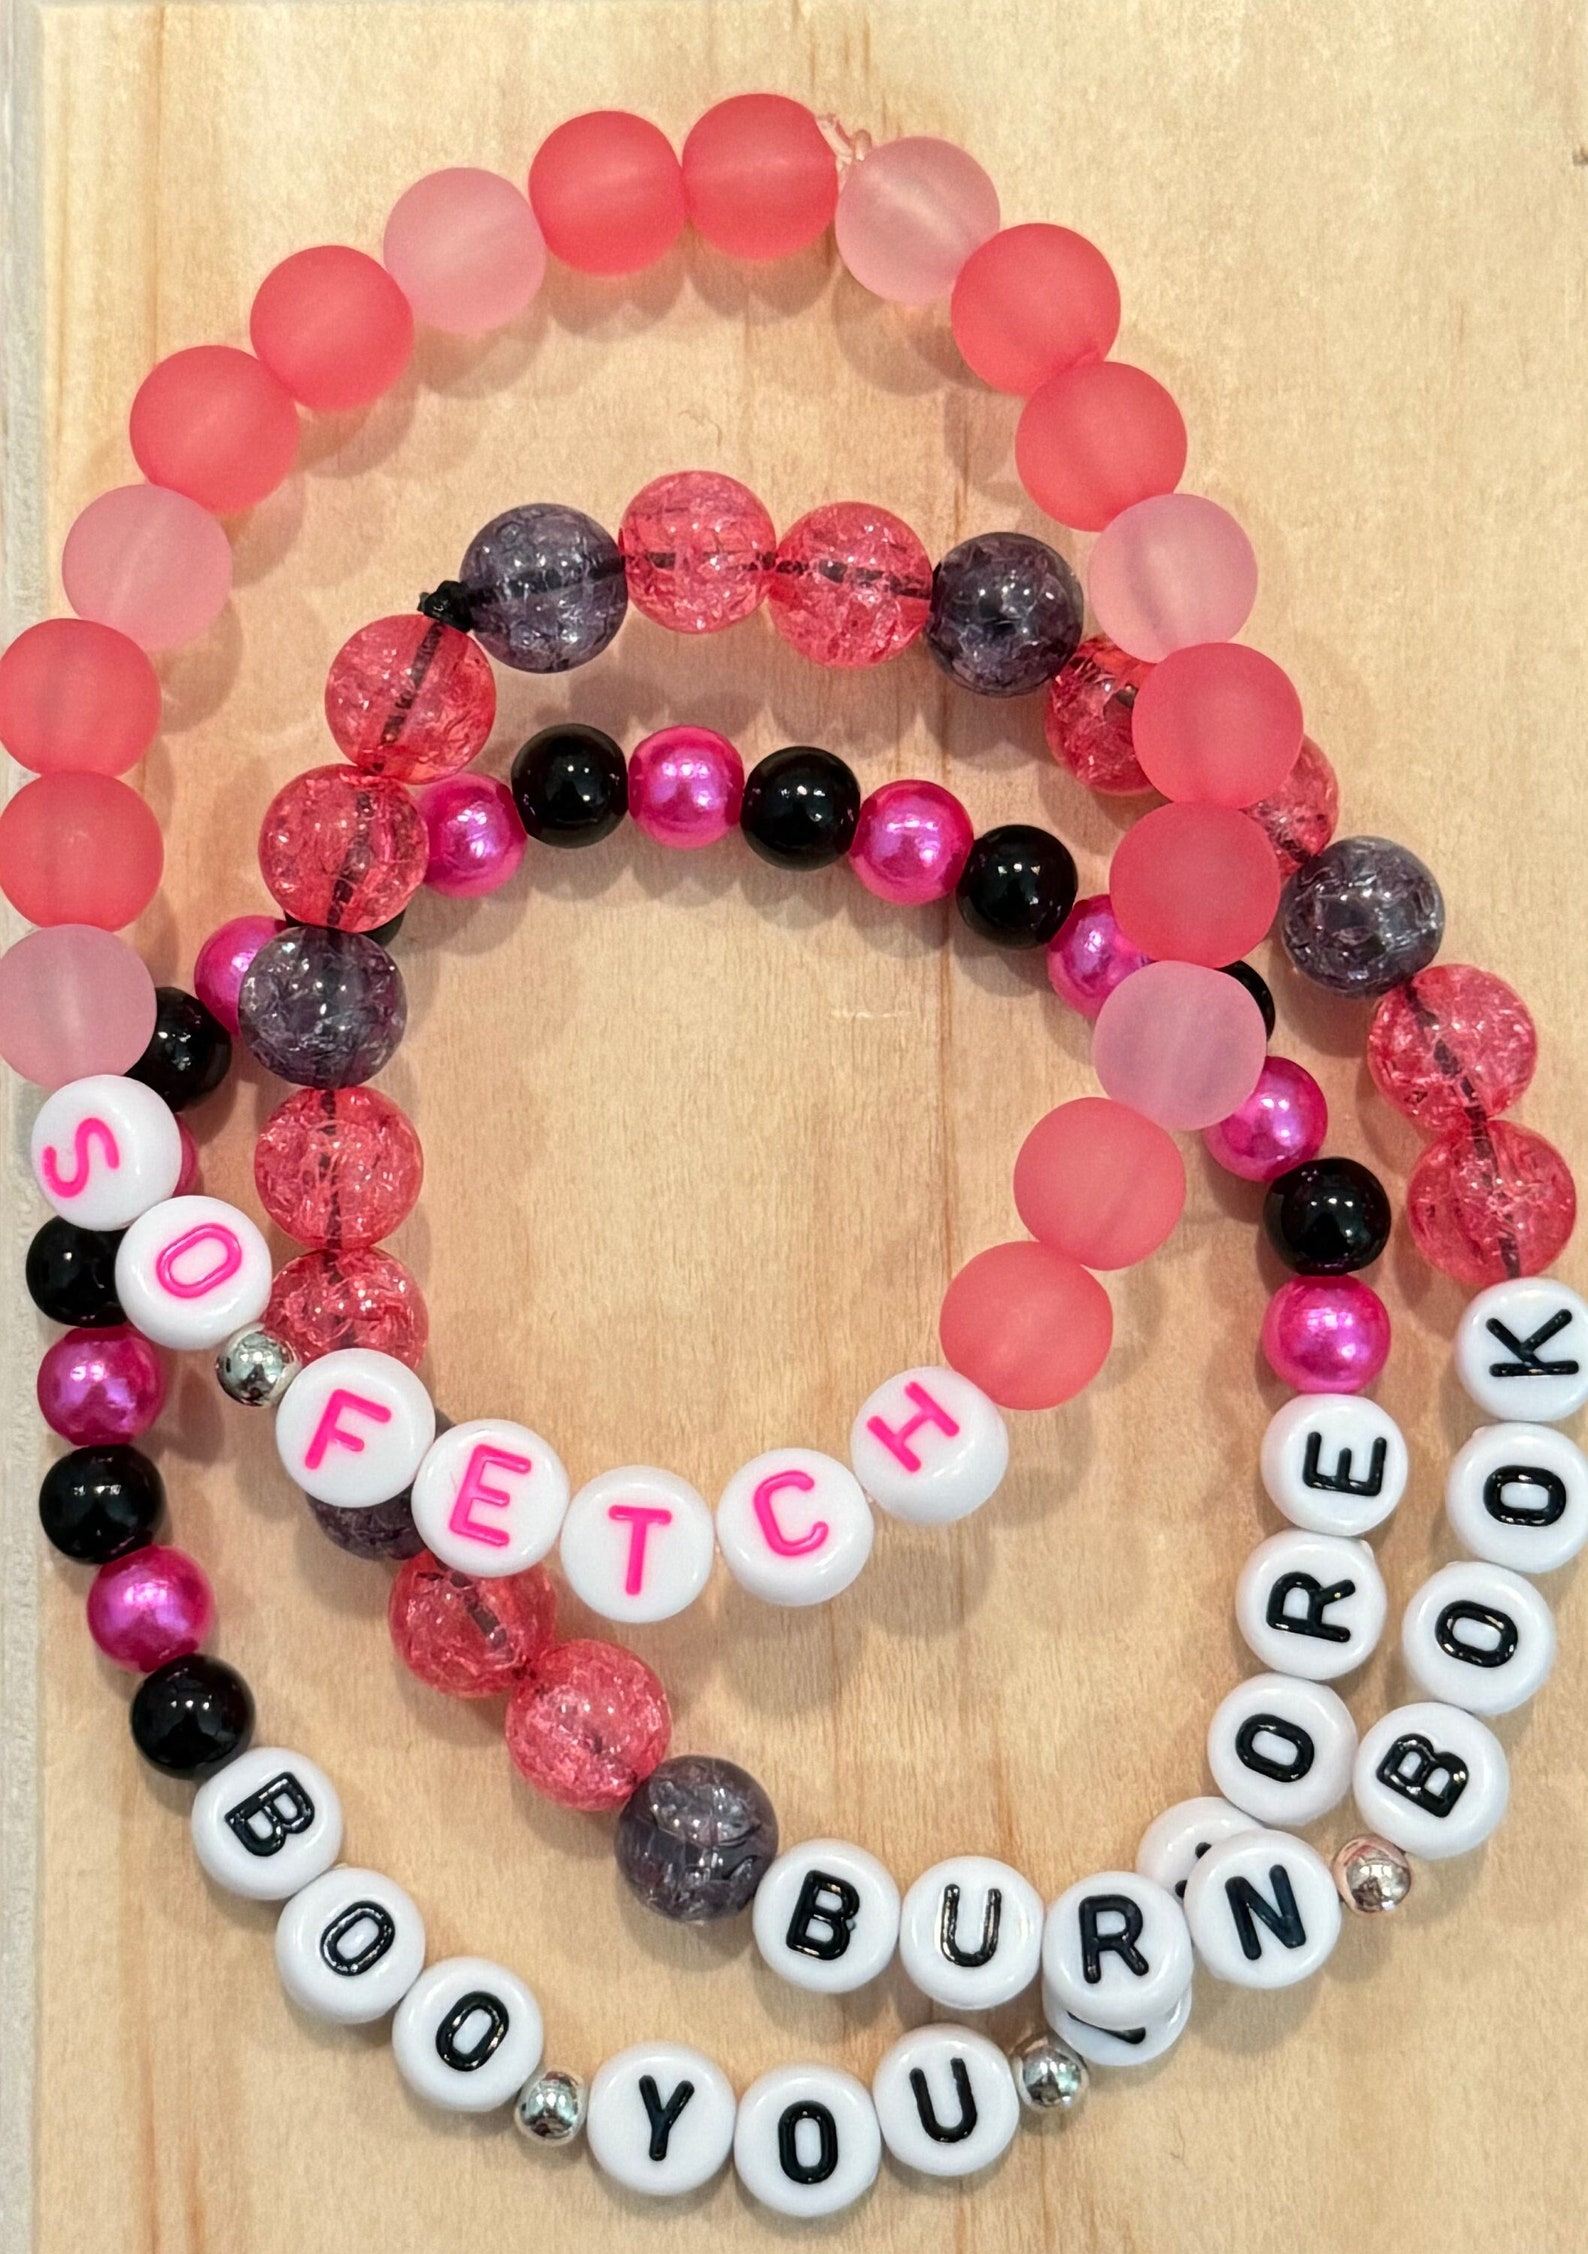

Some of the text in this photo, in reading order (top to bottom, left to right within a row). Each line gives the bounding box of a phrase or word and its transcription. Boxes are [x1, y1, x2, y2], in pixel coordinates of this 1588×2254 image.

[41, 1116, 961, 1597] SO FETCH
[785, 1307, 1580, 1985] BURN BOOK
[223, 1770, 511, 2073] BOO
[637, 2056, 979, 2186] YOU
